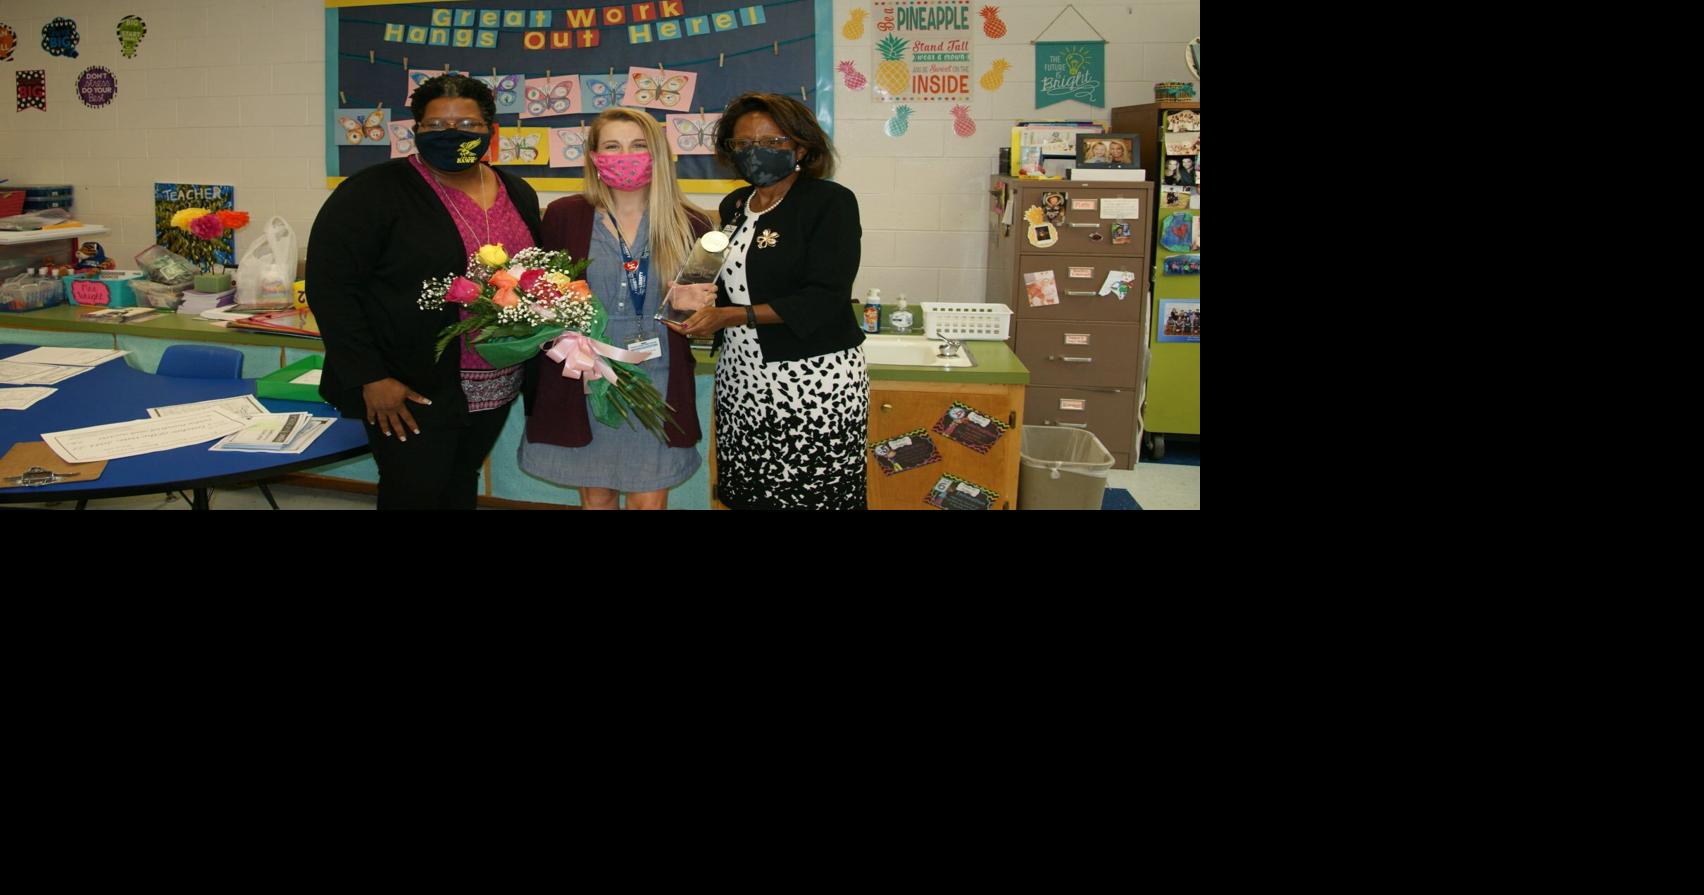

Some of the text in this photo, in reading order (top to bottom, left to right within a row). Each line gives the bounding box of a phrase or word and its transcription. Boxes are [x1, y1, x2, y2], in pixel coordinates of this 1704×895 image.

[432, 1, 680, 28] Great Work
[897, 6, 969, 31] PINEAPPLE
[385, 24, 497, 48] Hangs
[524, 30, 593, 50] Out
[912, 40, 969, 52] Stand Tall
[1044, 63, 1066, 71] FUTURE
[1050, 55, 1061, 63] THE
[912, 75, 969, 94] INSIDE
[1041, 70, 1094, 92] Bright
[20, 86, 43, 98] BIG
[162, 186, 223, 201] TEACHER
